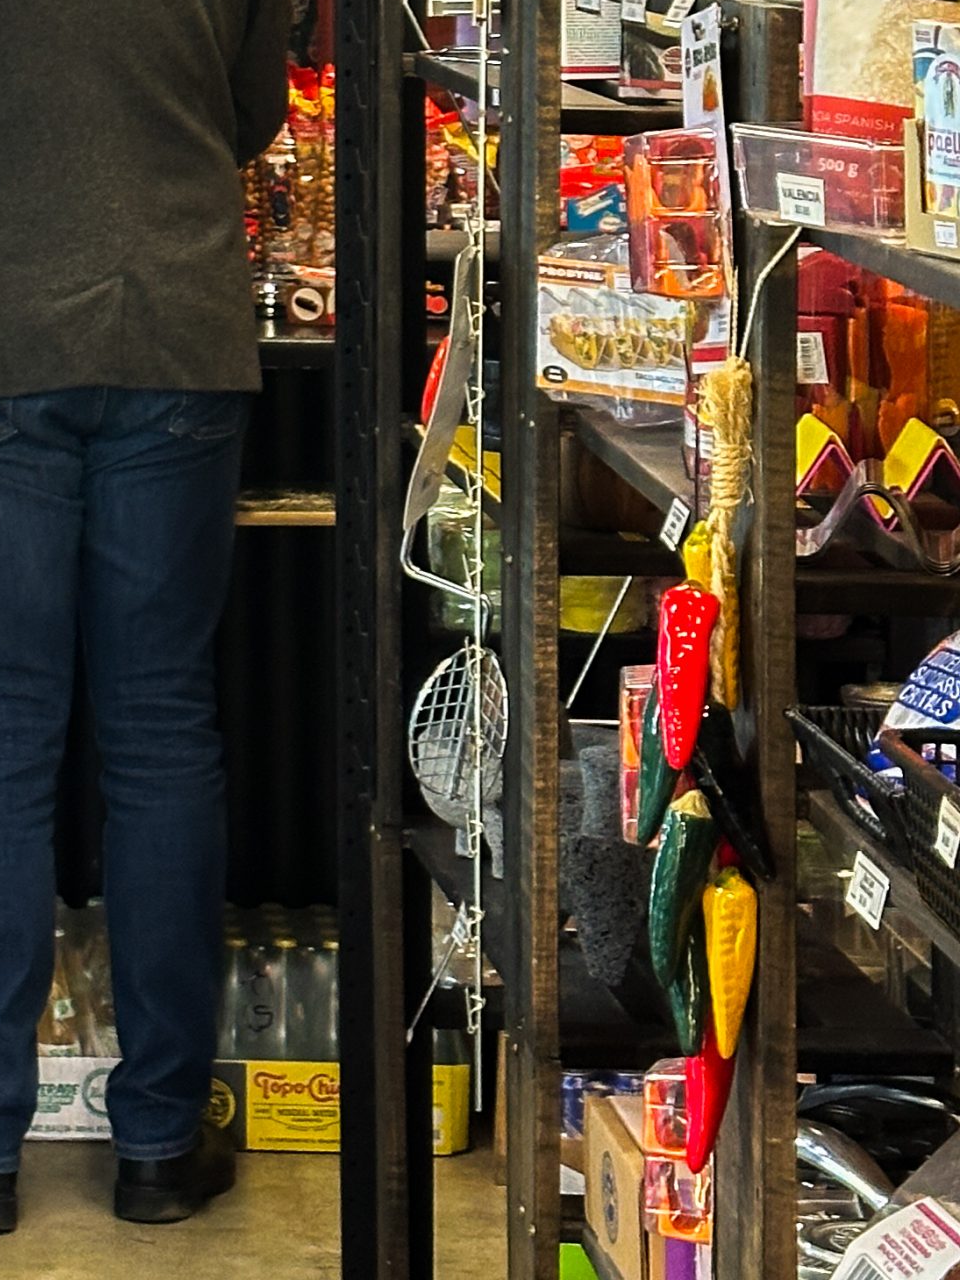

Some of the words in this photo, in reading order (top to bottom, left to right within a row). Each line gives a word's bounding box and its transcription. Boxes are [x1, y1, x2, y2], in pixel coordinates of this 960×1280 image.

[834, 112, 895, 132] SPANISH
[928, 130, 960, 157] paell
[818, 157, 845, 172] 500
[847, 163, 860, 178] g
[253, 1071, 307, 1100] Topo
